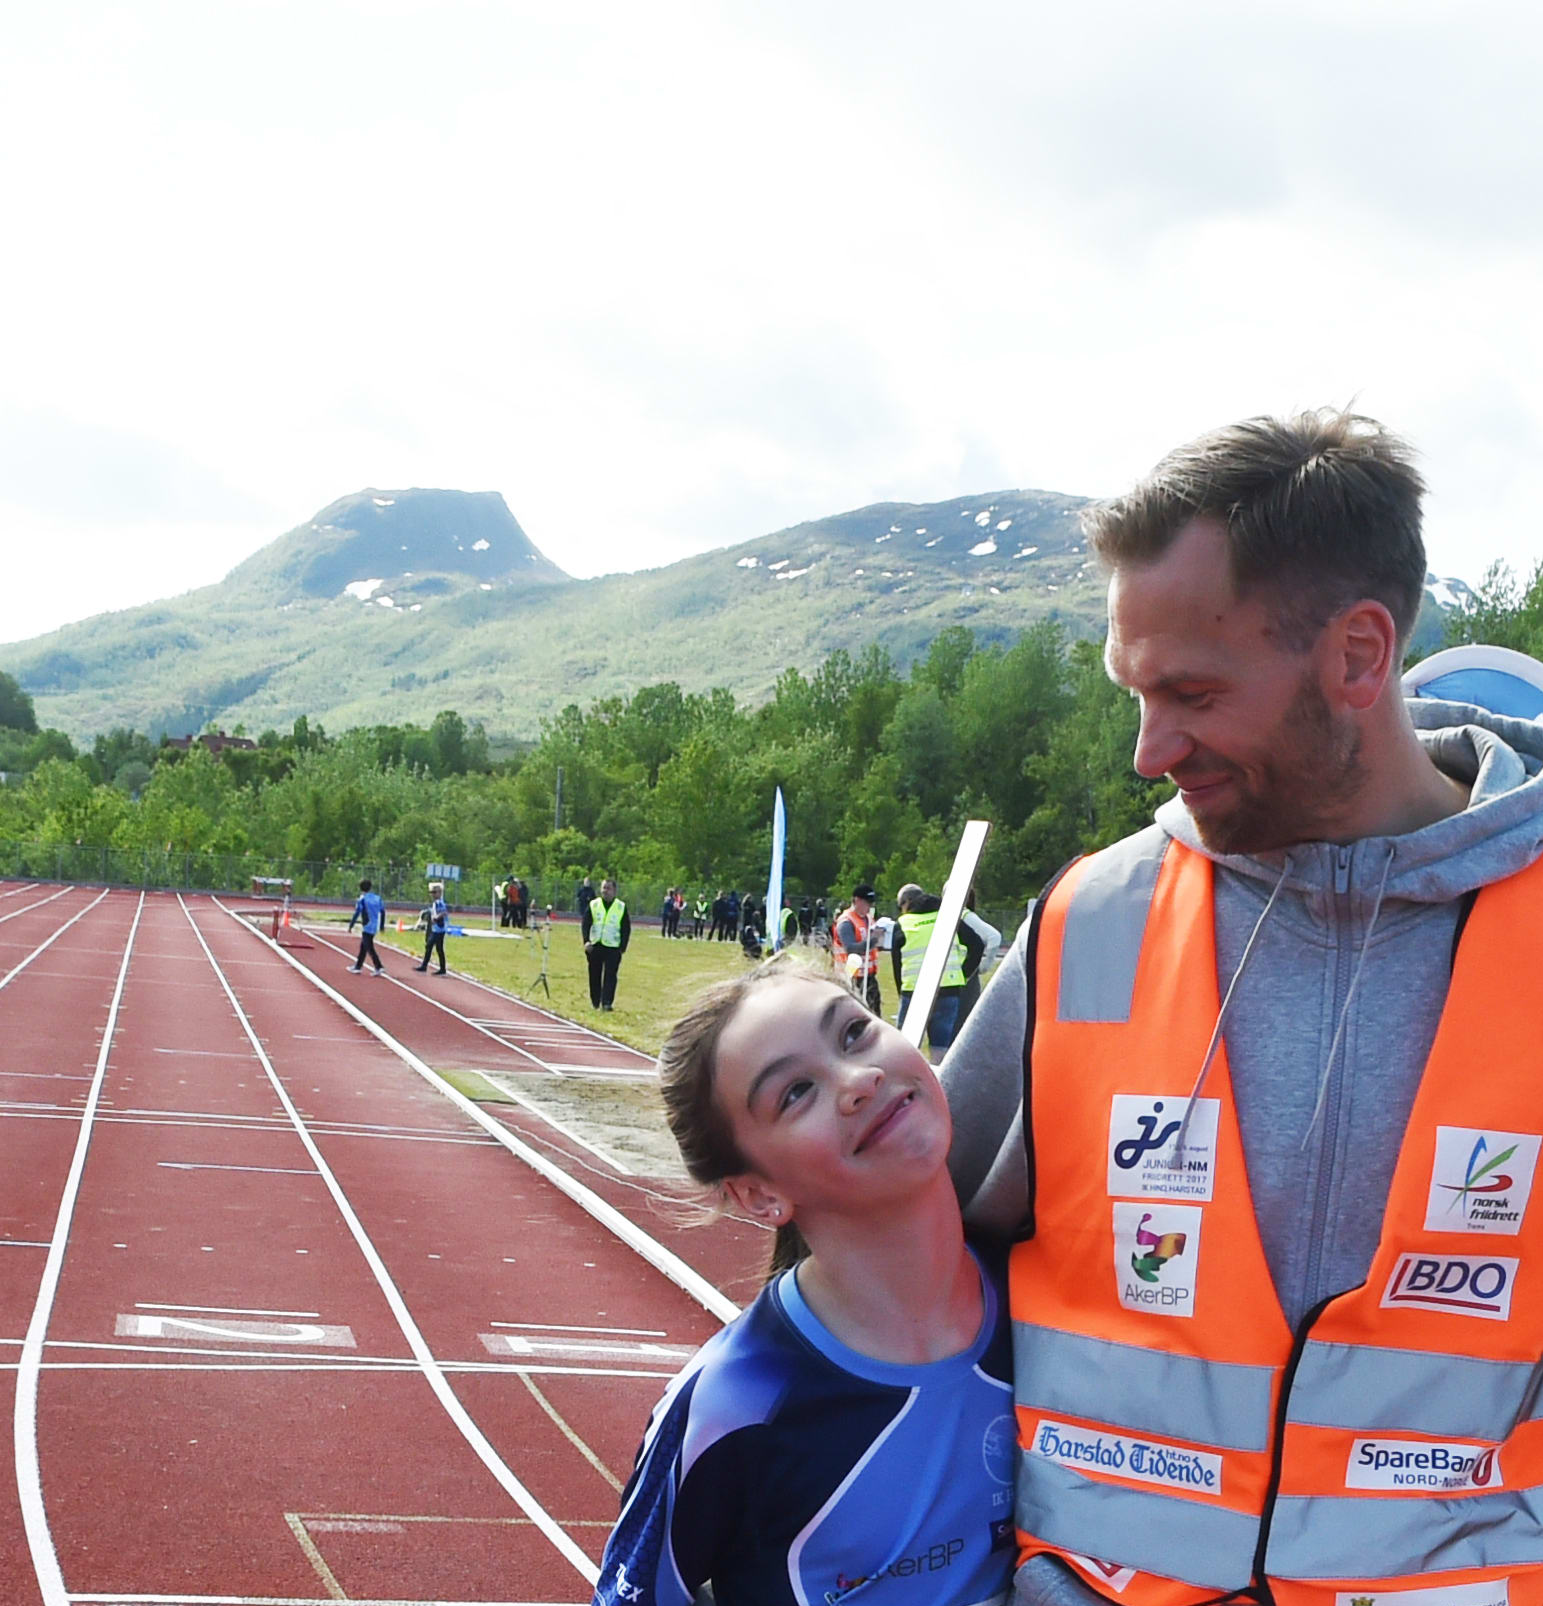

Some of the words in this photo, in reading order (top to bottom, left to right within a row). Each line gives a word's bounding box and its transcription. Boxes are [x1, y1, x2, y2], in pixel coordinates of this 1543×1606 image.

[1472, 1197, 1510, 1209] norsk
[1406, 1259, 1507, 1299] BDO
[1124, 1283, 1189, 1306] AkerBP
[1039, 1425, 1126, 1468] Harstad
[1129, 1443, 1216, 1487] Tidende
[1358, 1443, 1478, 1472] SpareBan
